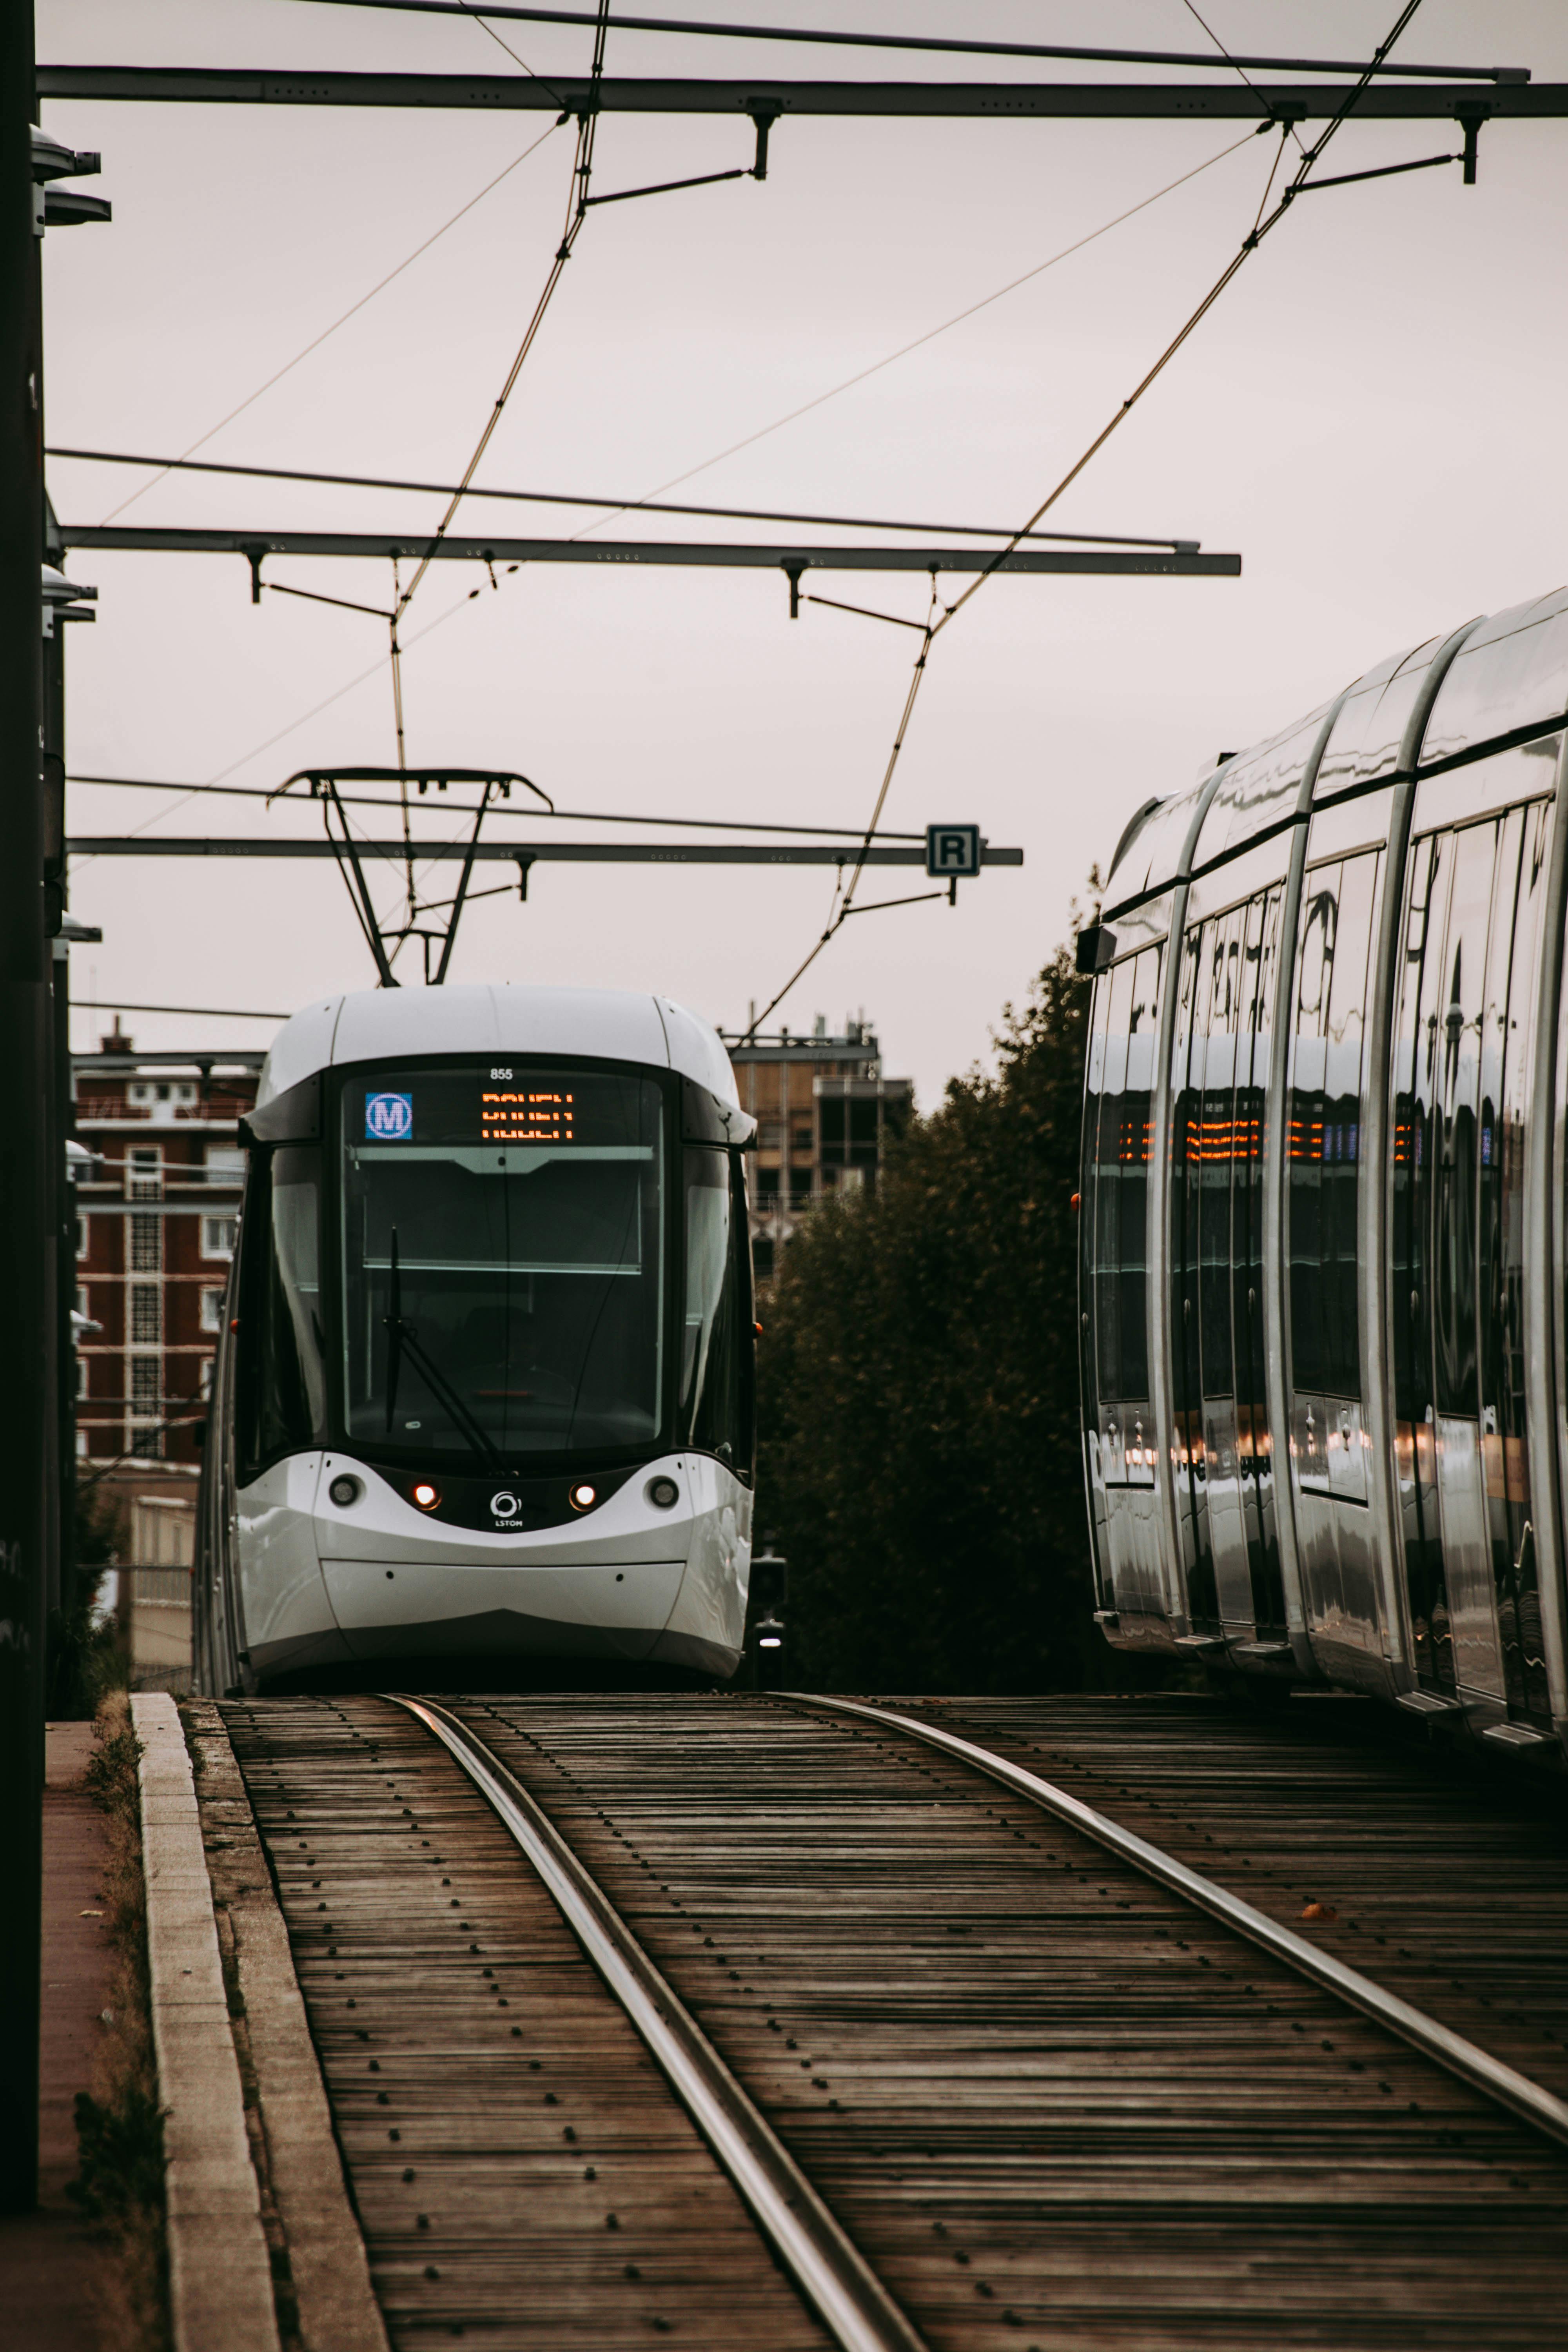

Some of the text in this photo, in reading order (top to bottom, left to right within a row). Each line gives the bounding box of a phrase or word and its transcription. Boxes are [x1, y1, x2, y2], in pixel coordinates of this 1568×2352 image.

[941, 835, 965, 865] R
[490, 1068, 513, 1080] 855
[374, 1102, 403, 1130] M
